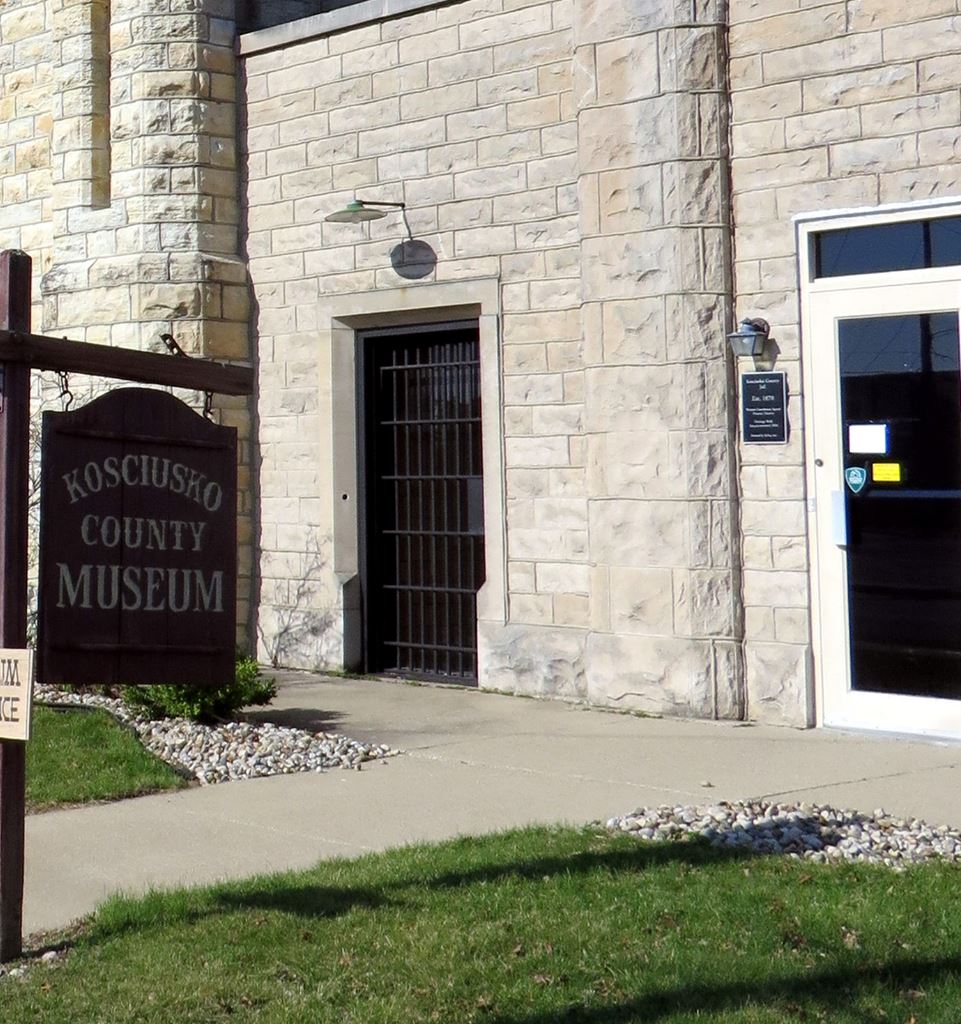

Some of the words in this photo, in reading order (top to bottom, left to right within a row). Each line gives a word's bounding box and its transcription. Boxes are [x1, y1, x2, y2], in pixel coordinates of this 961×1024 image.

[61, 454, 224, 512] KOSCIUSKO
[80, 513, 207, 551] COUNTY
[55, 562, 225, 613] MUSEUM
